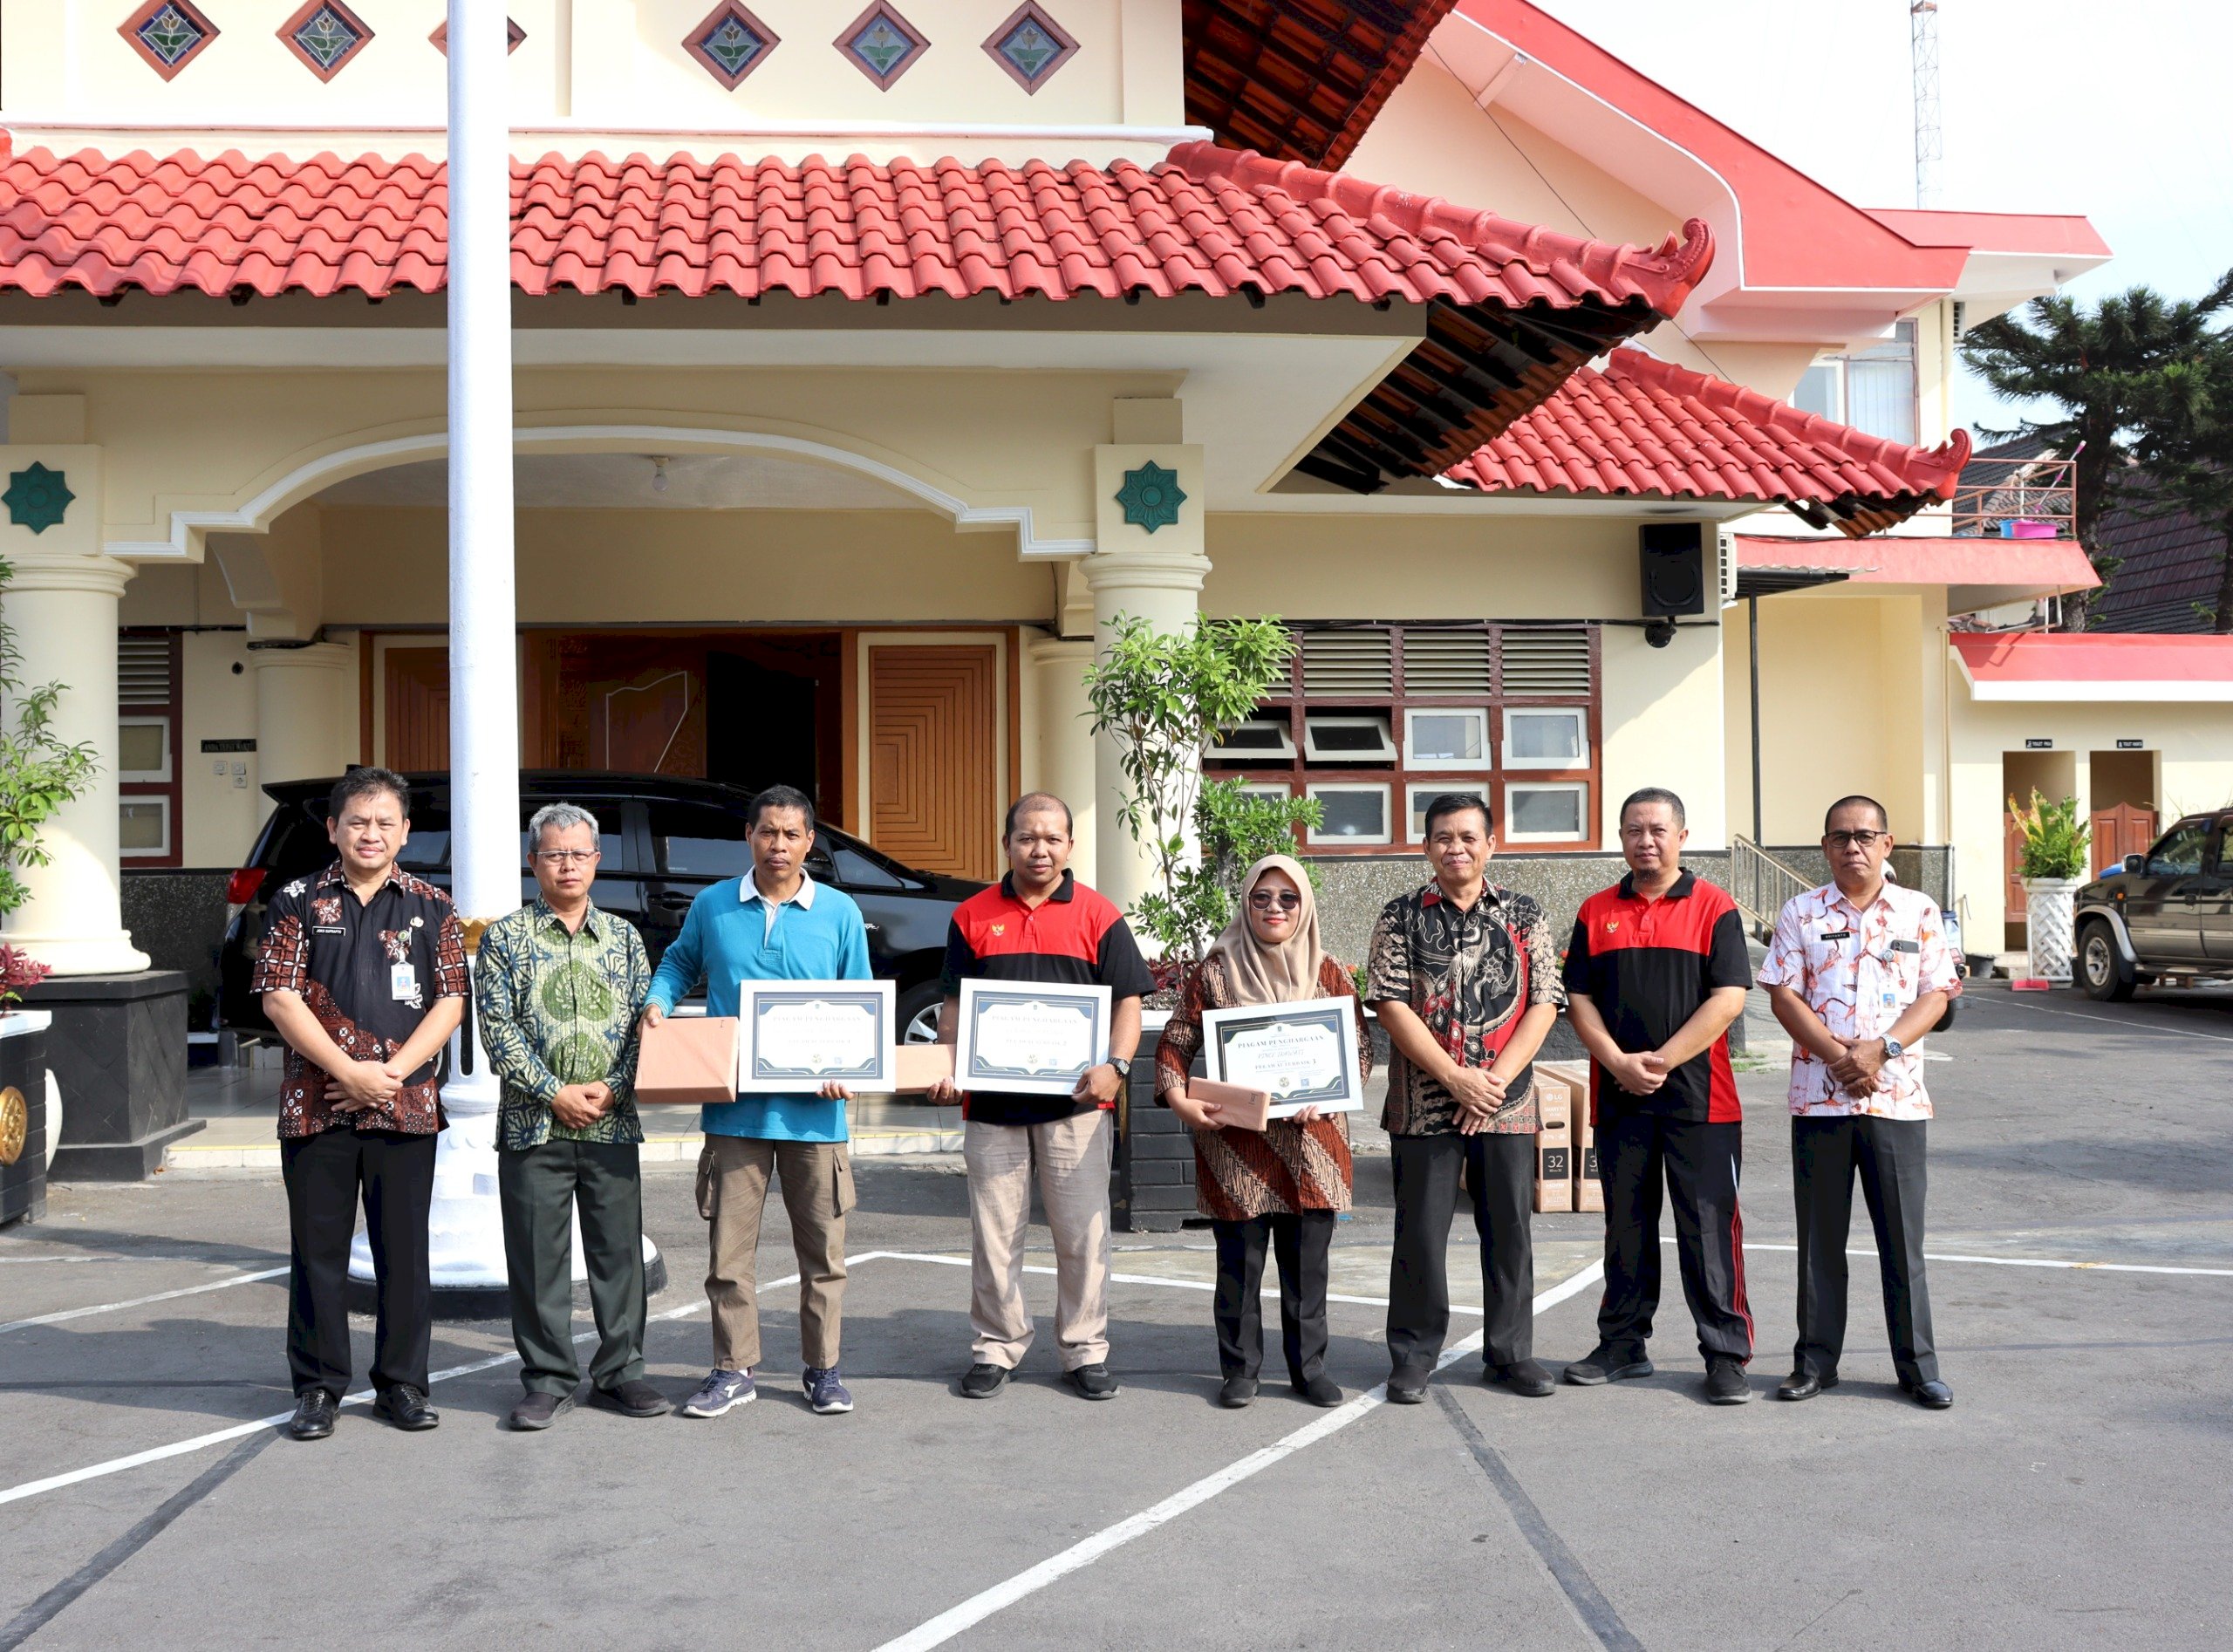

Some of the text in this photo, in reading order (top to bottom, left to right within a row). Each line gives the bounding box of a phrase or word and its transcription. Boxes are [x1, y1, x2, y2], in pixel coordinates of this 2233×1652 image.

[1238, 1041, 1267, 1049] PIAGAM
[1268, 1034, 1324, 1046] PENGHARGAAN
[1547, 1156, 1564, 1168] 32
